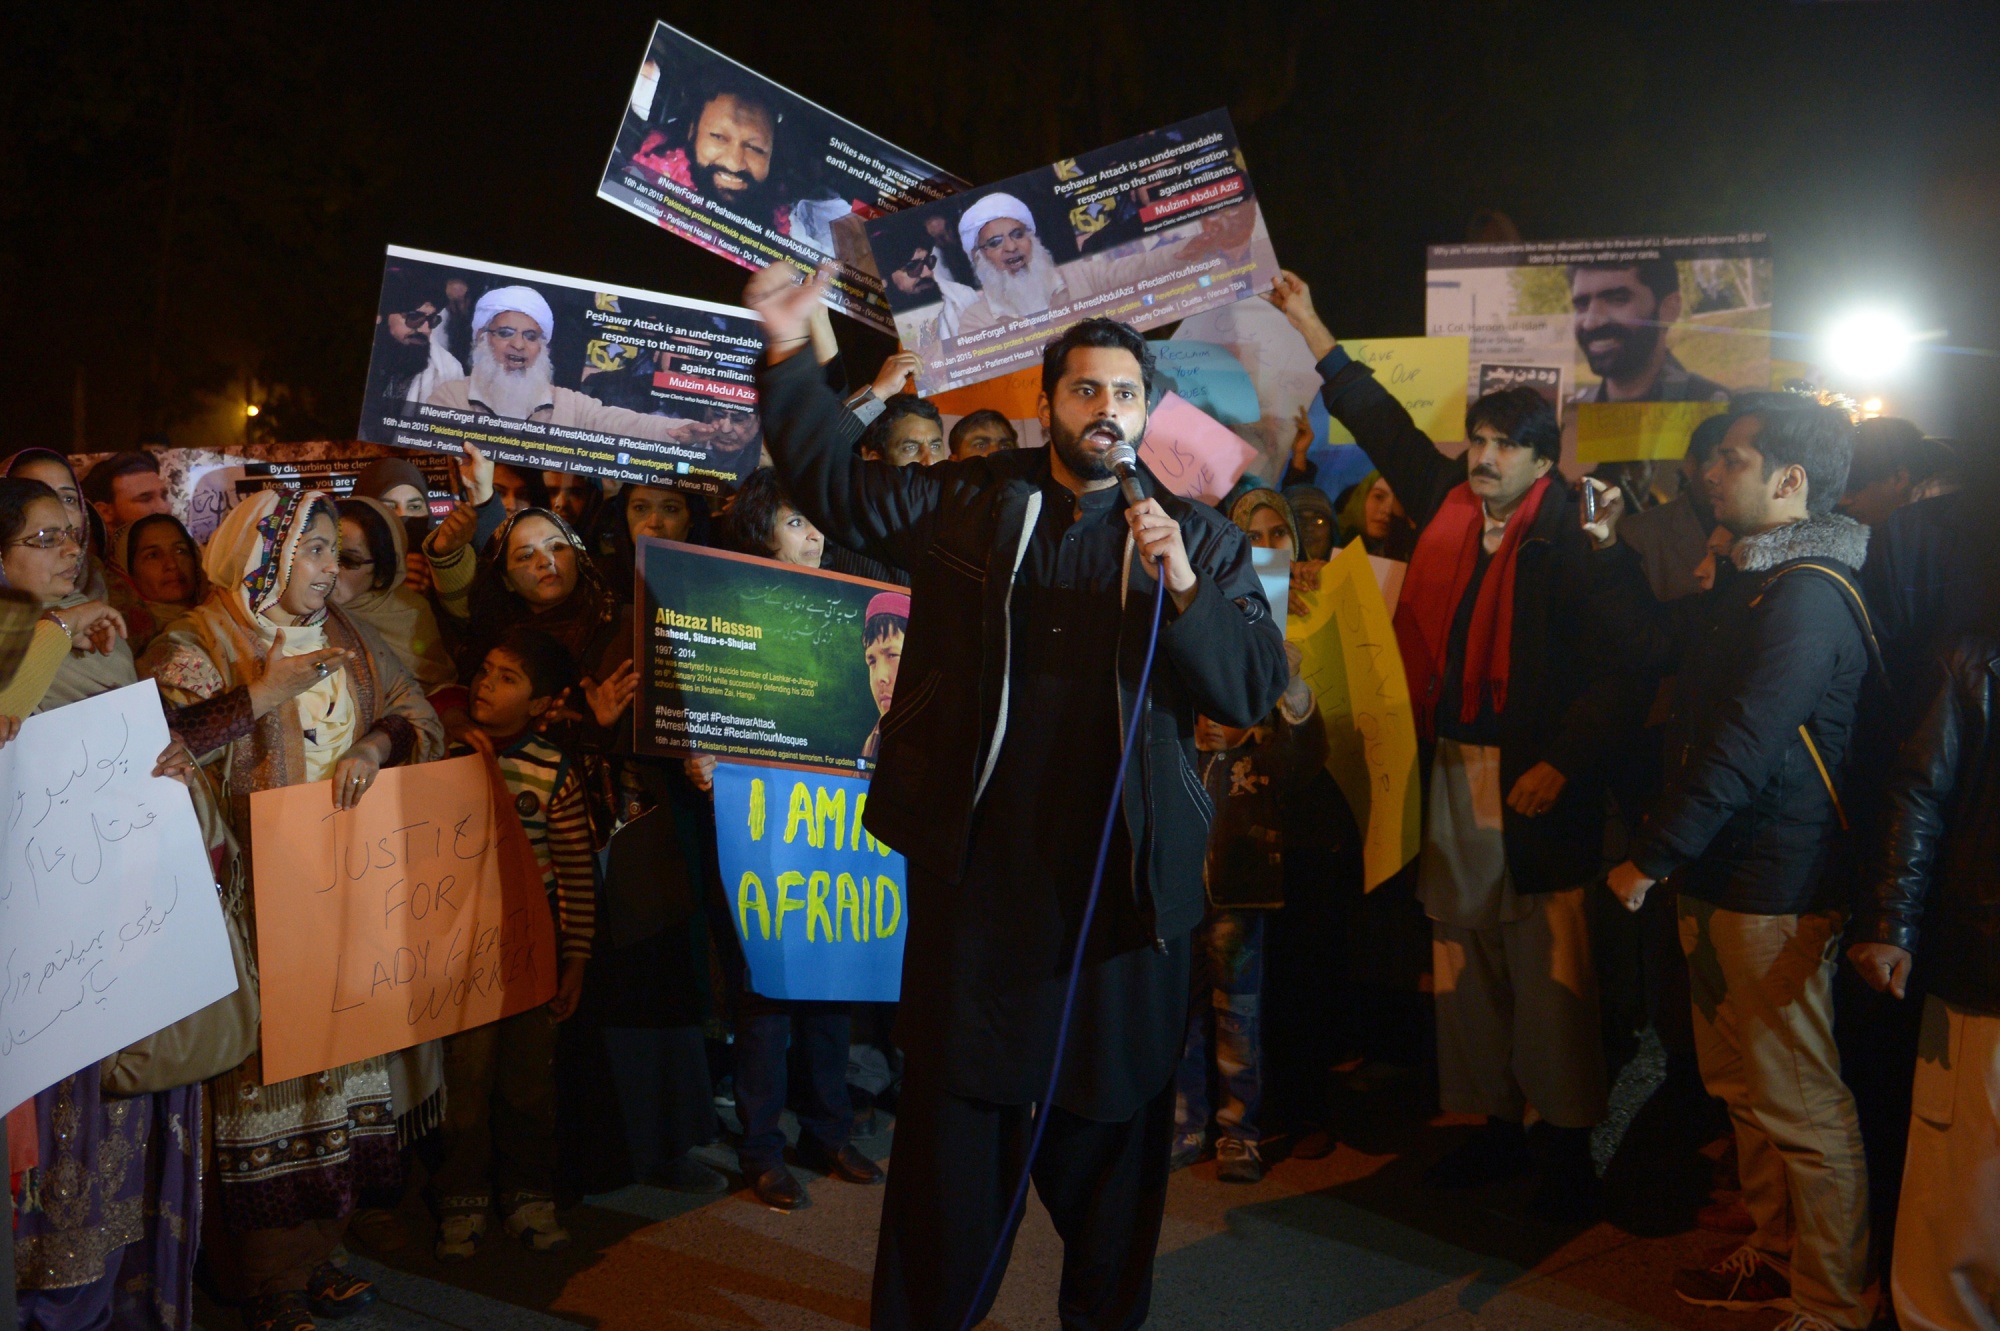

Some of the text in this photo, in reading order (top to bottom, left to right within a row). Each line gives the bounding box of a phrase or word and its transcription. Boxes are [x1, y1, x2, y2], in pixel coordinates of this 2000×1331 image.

[825, 152, 849, 170] earth
[847, 164, 865, 179] and
[863, 172, 898, 195] Pakistan
[828, 136, 919, 190] Shi'ites are the greatest
[1053, 131, 1223, 194] Peshawar Attack is an understandable
[1076, 148, 1229, 207] response to the military operation
[1158, 163, 1236, 198] against militants.
[1154, 180, 1239, 215] Mulzim Abdul Aziz
[655, 176, 705, 208] #NeverForget
[705, 199, 765, 233] #PeshawarAttack
[763, 228, 821, 261] #ArrestAbdulAziz
[956, 256, 1221, 348] #NeverForget #PeshawarAttack #ArrestAbdulAziz #ReclaimYourMosques
[584, 310, 762, 349] Peshawar Attack is an understandable
[601, 333, 645, 348] response
[647, 339, 658, 348] to
[659, 341, 675, 351] the
[676, 344, 712, 359] military
[1159, 344, 1210, 360] RECLAIM
[1358, 344, 1394, 363] SAVE
[680, 362, 715, 377] against
[1173, 365, 1200, 376] YOUR
[668, 377, 756, 399] Mulzim Abdul Aziz
[382, 417, 397, 426] 16th
[398, 419, 411, 428] Jan
[411, 421, 429, 431] 2015
[429, 424, 463, 437] Pakistanis
[463, 430, 486, 443] protest
[487, 434, 520, 446] worldwide
[520, 440, 544, 452] against
[544, 442, 575, 454] terrorism.
[576, 448, 588, 456] For
[589, 450, 615, 463] updates
[419, 406, 706, 462] #NeverForget #PeshawarAttack #ArrestAbdulAziz #ReclaimYourMosques
[269, 459, 350, 477] By disturbing the
[397, 434, 432, 447] Islamabad
[498, 450, 524, 462] Karachi
[528, 456, 539, 464] Do
[539, 457, 562, 468] Talwar
[570, 462, 593, 472] Lahore
[597, 467, 619, 478] Liberty
[620, 470, 643, 480] Chowk
[650, 475, 672, 485] Quetta
[411, 456, 446, 466] the Red
[1159, 438, 1194, 478] US
[262, 478, 350, 493] Mosque you are
[427, 473, 448, 483] your
[655, 608, 764, 638] Aitazaz Hassan
[654, 627, 757, 652] Shaheed, Sitara-e-Shujaat
[654, 644, 696, 658] 1997 2014
[672, 670, 696, 682] January
[696, 674, 711, 683] 2014
[712, 676, 727, 685] while
[728, 678, 762, 692] successfully
[763, 683, 791, 696] defending
[800, 688, 814, 697] 2000
[677, 660, 704, 672] martyred
[704, 664, 712, 673] by
[718, 666, 738, 675] suicide
[739, 669, 761, 678] bomber
[654, 679, 674, 688] school
[674, 682, 693, 691] mates
[701, 686, 722, 695] Ibrahim
[723, 689, 735, 698] Zai,
[735, 690, 756, 701] Hangu.
[655, 706, 776, 728] #NeverForget #PeshawarAttack
[655, 718, 808, 748] #ArrestAbdulAziz #ReclaimYourMosques
[748, 778, 766, 841] I
[783, 781, 846, 851] AM
[385, 874, 458, 930] FOR
[738, 870, 901, 943] AFRAID
[331, 940, 431, 1013] LADY
